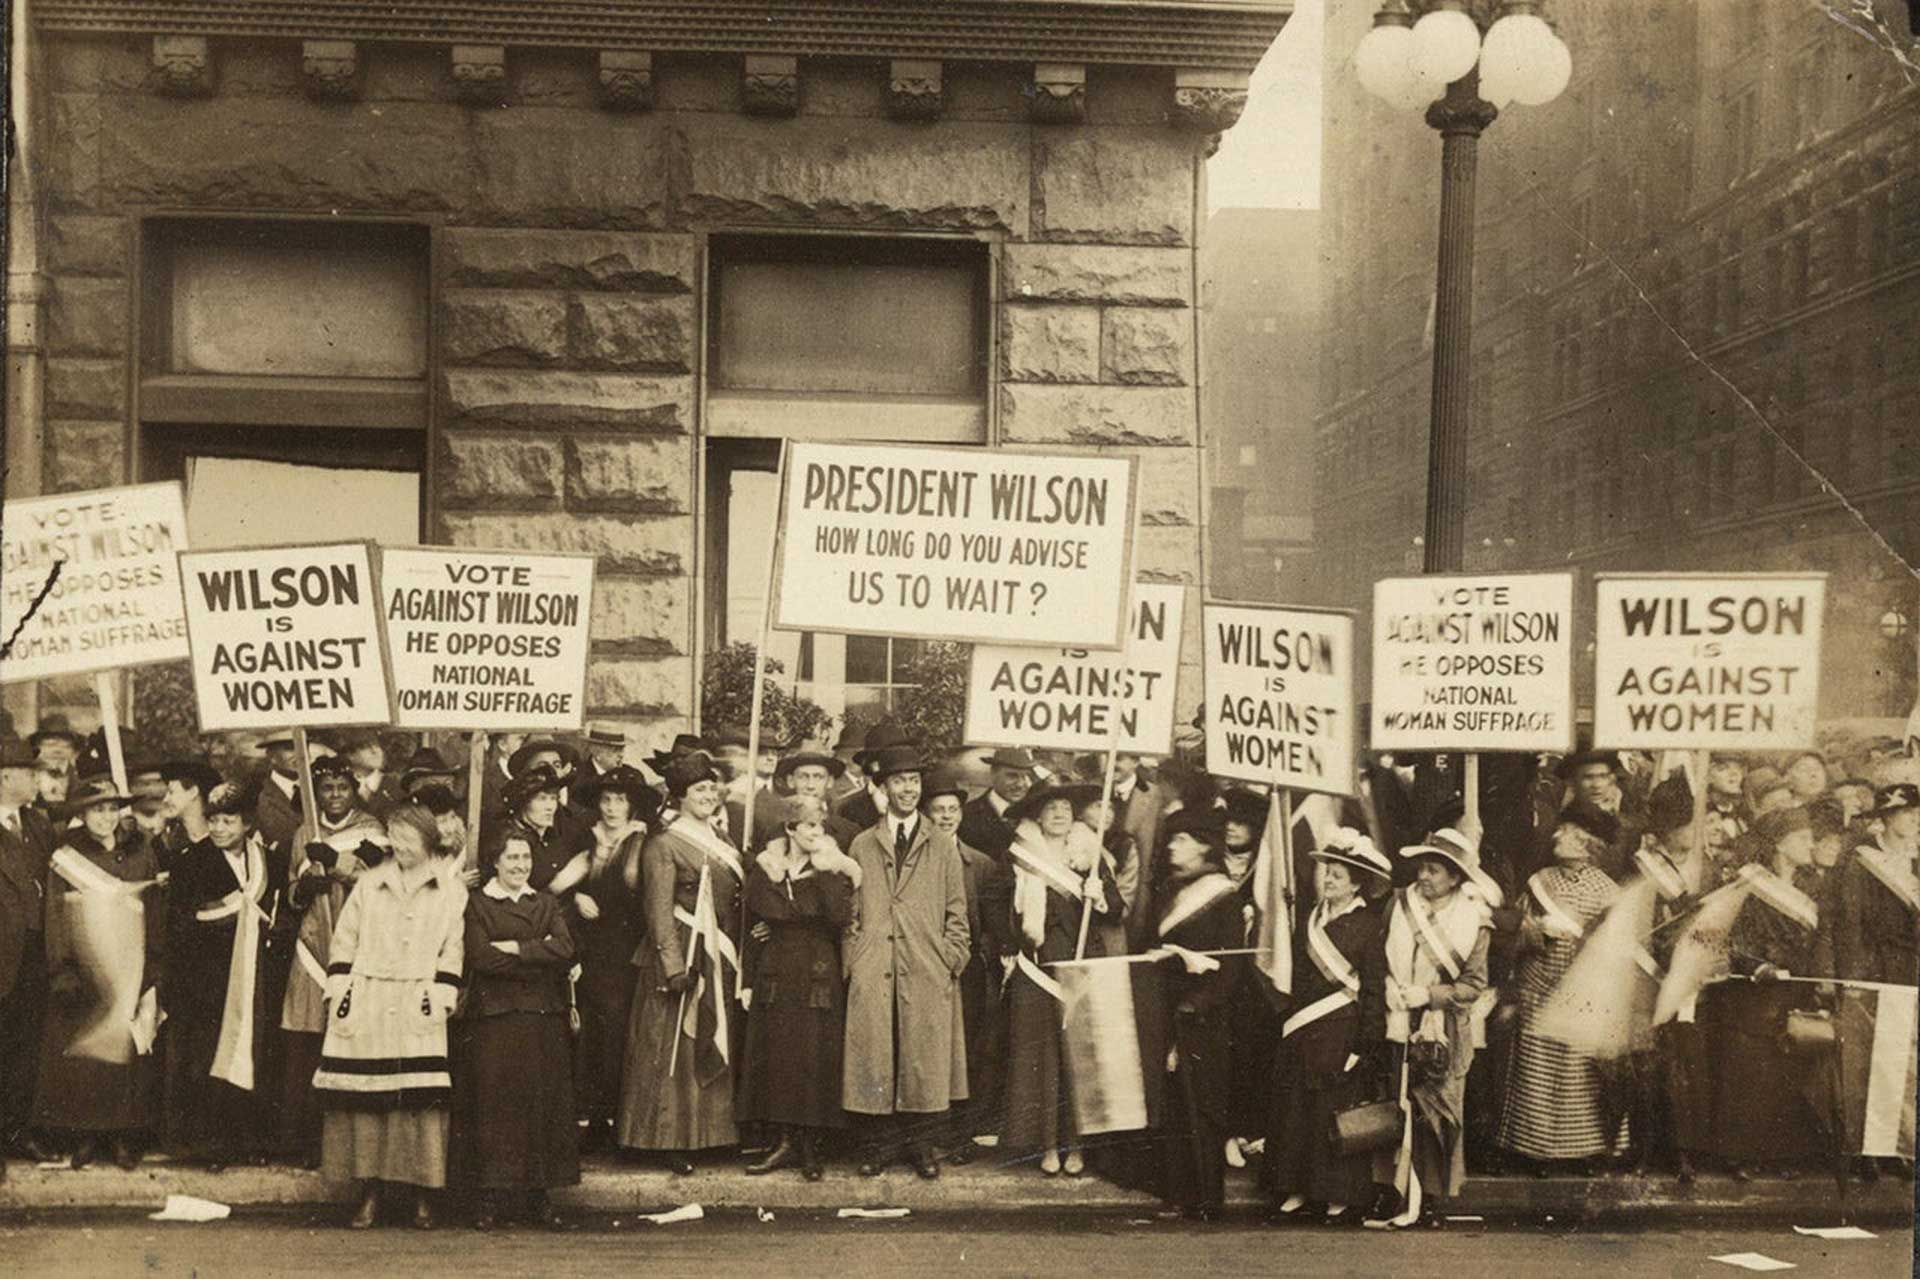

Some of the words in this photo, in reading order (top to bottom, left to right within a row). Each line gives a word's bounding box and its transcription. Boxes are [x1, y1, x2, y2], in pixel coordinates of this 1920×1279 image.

[804, 462, 978, 519] PRESIDENT
[990, 472, 1109, 526] WILSON
[815, 525, 862, 555] HOW
[866, 529, 914, 559] LONG
[924, 533, 951, 560] DO
[961, 534, 1000, 564] YOU
[1009, 539, 1089, 569] ADVISE
[197, 563, 360, 613] WILSON
[445, 563, 532, 586] VOTE
[848, 570, 884, 605] US
[896, 573, 931, 609] TO
[41, 600, 145, 629] NATIONAL
[388, 587, 490, 623] AGAINST
[496, 590, 579, 626] WILSON
[1620, 595, 1805, 637] WILSON
[79, 617, 186, 651] SUFFRAGE
[266, 616, 293, 633] IS
[1481, 612, 1559, 644] WILSON
[211, 637, 367, 674] AGAINST
[406, 631, 439, 653] HE
[446, 632, 562, 658] OPPOSES
[1218, 622, 1336, 676] WILSON
[432, 664, 535, 686] NATIONAL
[990, 661, 1162, 700] AGAINST
[1436, 654, 1544, 676] OPPOSES
[1616, 666, 1800, 696] AGAINST
[222, 677, 356, 713] WOMEN
[1264, 676, 1285, 692] IS
[1423, 685, 1517, 706] NATIONAL
[463, 691, 573, 714] SUFFRAGE
[999, 699, 1138, 738] WOMEN
[1219, 693, 1337, 738] AGAINST
[1627, 704, 1775, 732] WOMEN
[1384, 710, 1446, 731] WOMAN
[1453, 710, 1556, 732] SUFFRAGE
[1226, 731, 1322, 777] WOMEN
